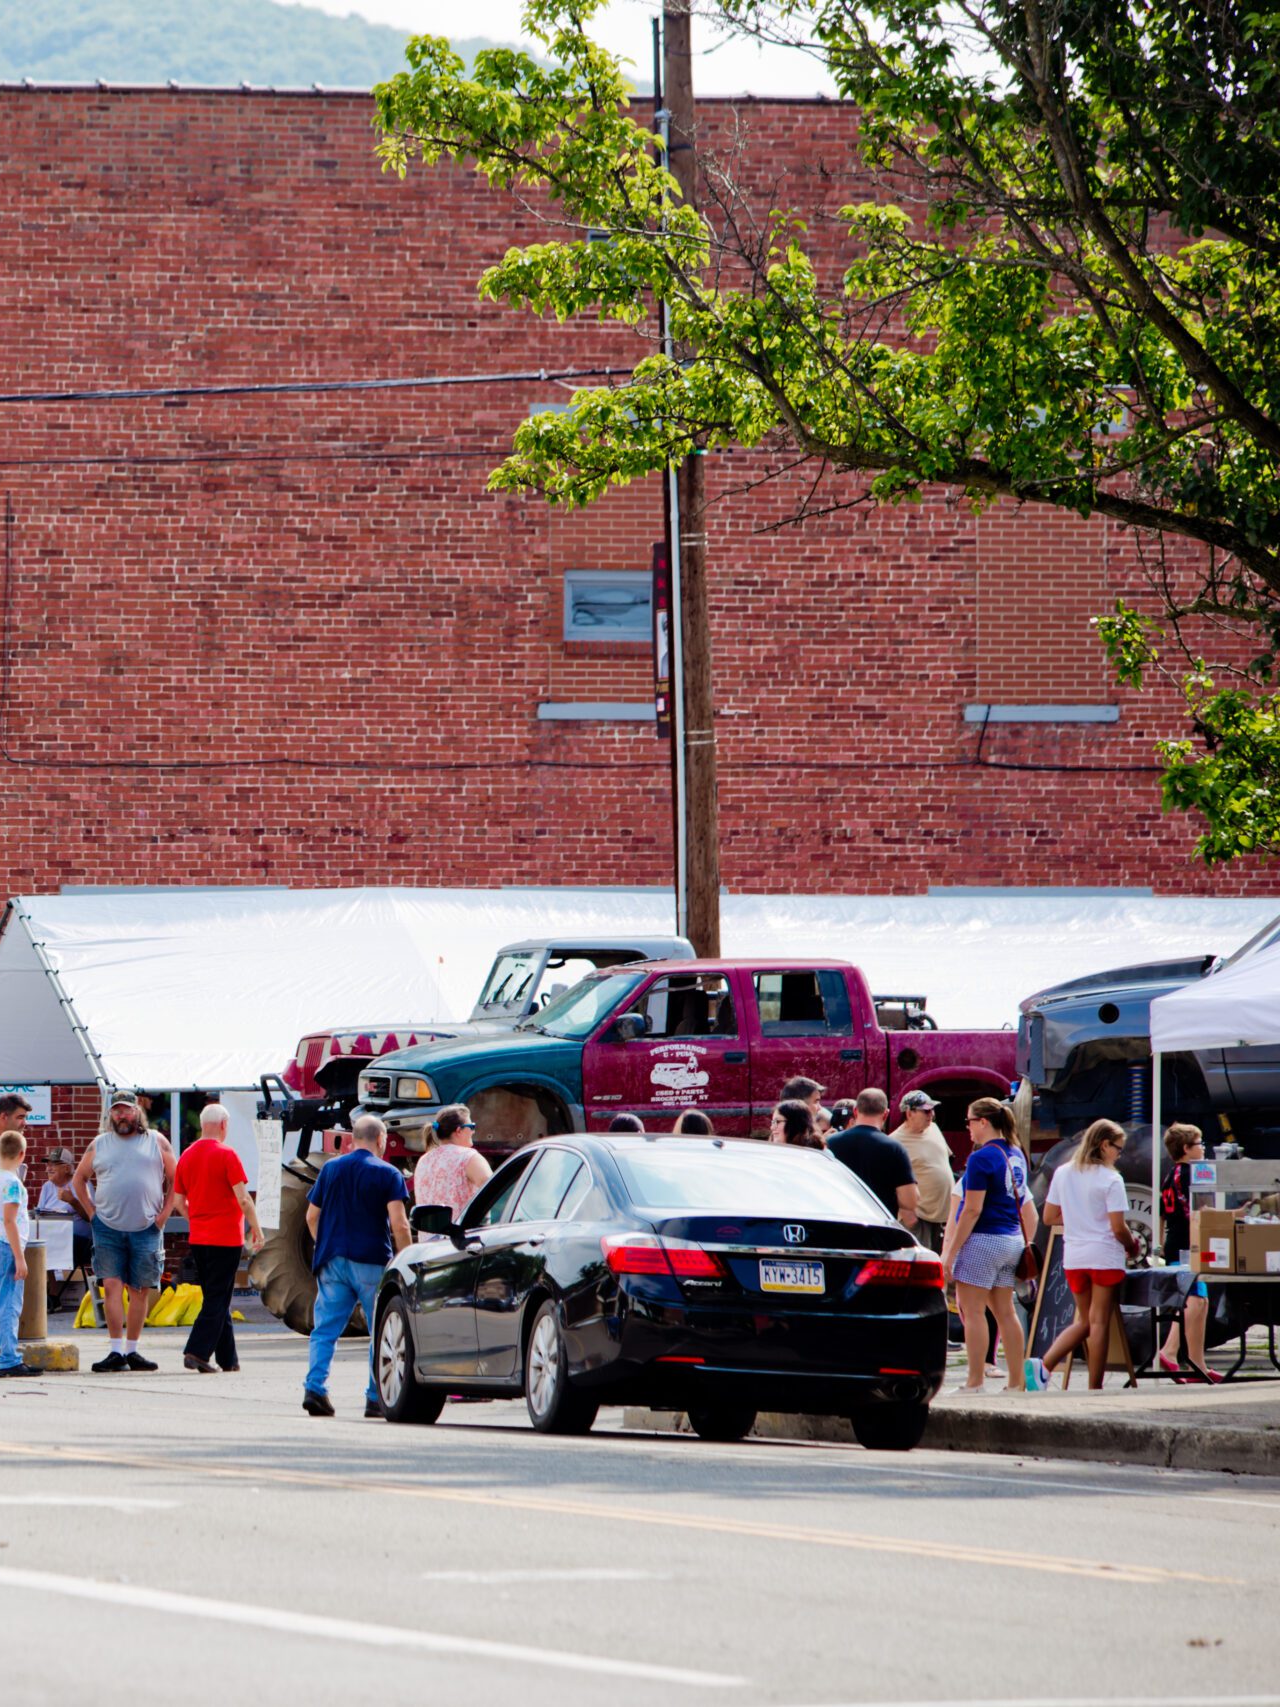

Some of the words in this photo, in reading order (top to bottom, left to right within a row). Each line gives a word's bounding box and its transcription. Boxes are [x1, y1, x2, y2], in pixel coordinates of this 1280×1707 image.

[650, 1044, 707, 1056] PERFORMANCE
[764, 1267, 820, 1285] KYW-3415
[683, 1279, 722, 1287] Accord
